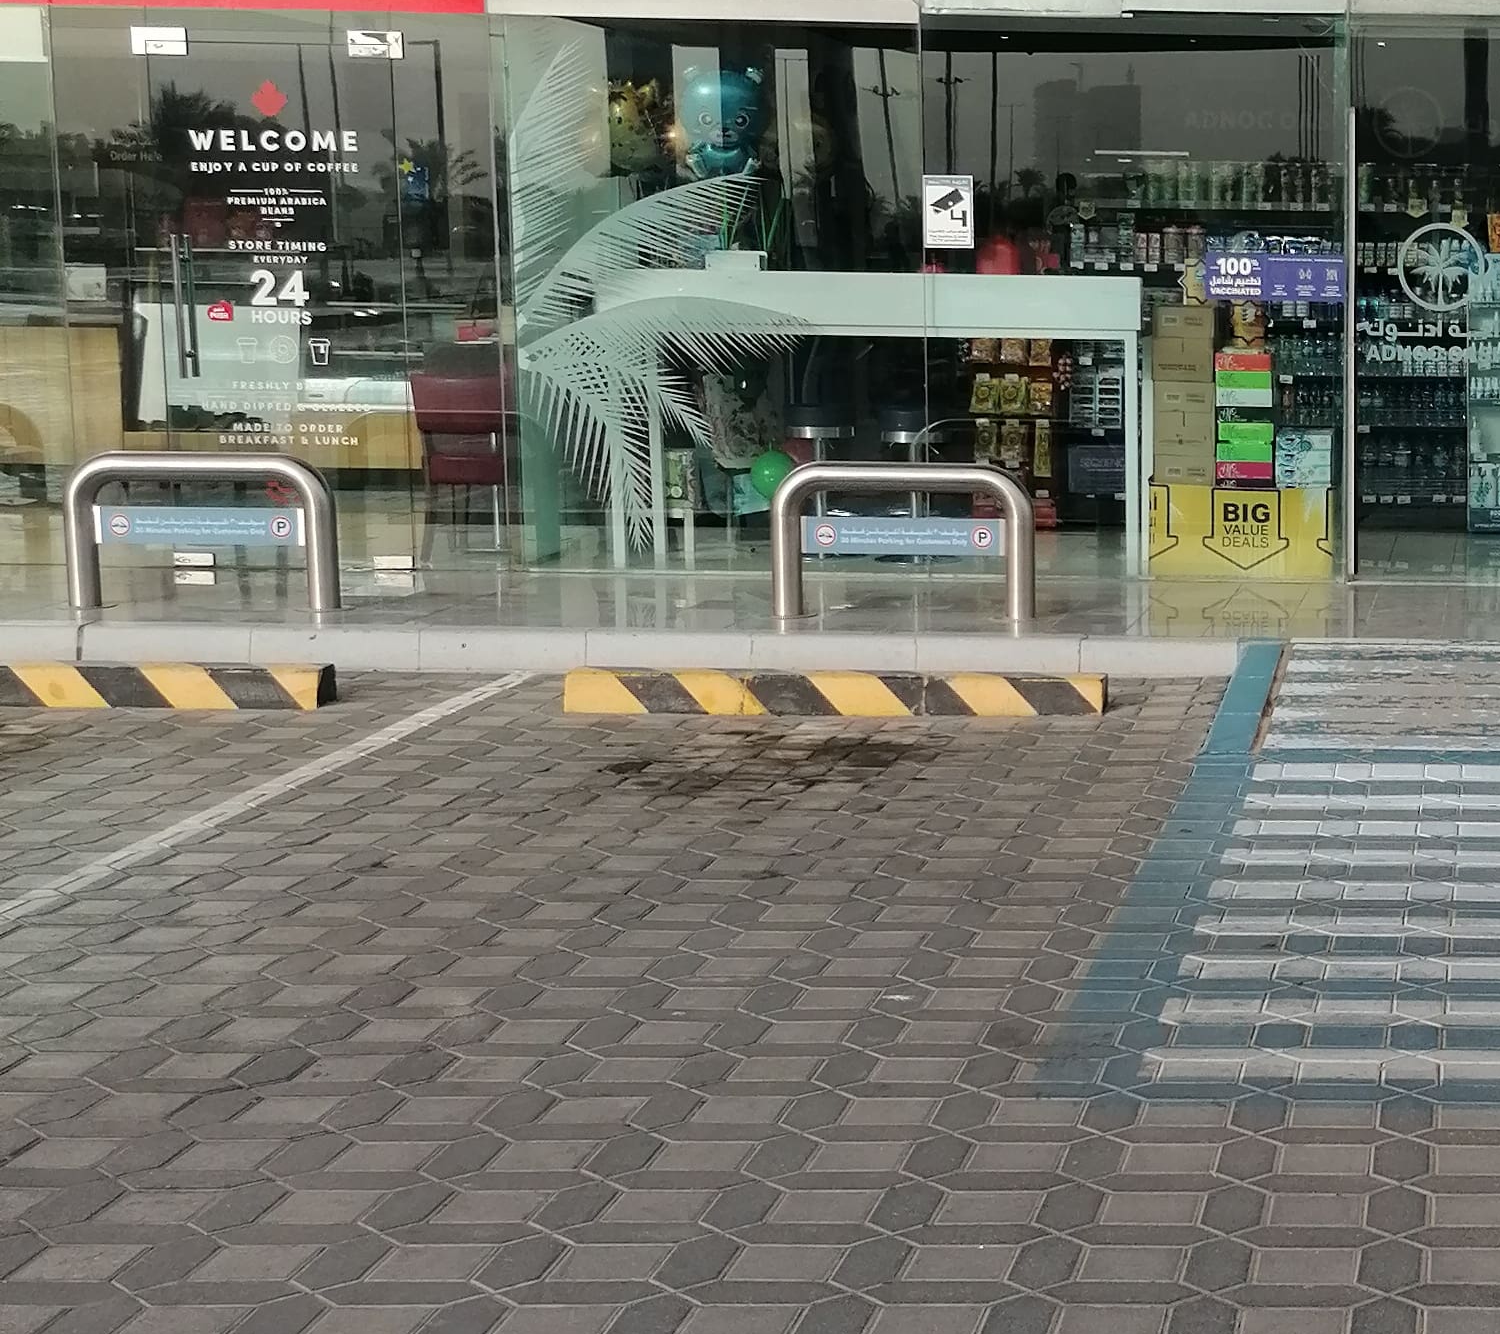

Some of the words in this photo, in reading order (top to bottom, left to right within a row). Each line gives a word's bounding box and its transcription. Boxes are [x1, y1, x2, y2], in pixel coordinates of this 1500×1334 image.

[188, 129, 359, 152] WELCOME
[190, 162, 233, 174] ENJOY
[238, 162, 248, 173] A
[251, 162, 279, 172] CUP
[283, 163, 302, 173] OF
[307, 163, 360, 174] COFFEE
[226, 196, 277, 206] PREMIUM
[279, 198, 327, 206] ARABICA
[228, 240, 272, 251] STORE
[274, 241, 327, 252] TIMING
[253, 255, 309, 264] EVERYDAY
[251, 269, 310, 307] 24
[1209, 287, 1262, 296] VACCINATED
[251, 310, 313, 325] HOURS
[232, 380, 290, 390] FRESHLY
[201, 400, 237, 411] HAND
[243, 400, 292, 411] DIPPED
[233, 423, 272, 433] MADE
[273, 424, 294, 433] TO
[299, 424, 344, 434] ORDER
[219, 435, 294, 445] BREAKFAST
[315, 436, 359, 446] LUNCH
[1223, 503, 1270, 523] BIG
[277, 521, 286, 532] P
[1223, 524, 1269, 536] VALUE
[979, 531, 987, 543] P
[1221, 536, 1269, 548] DEALS
